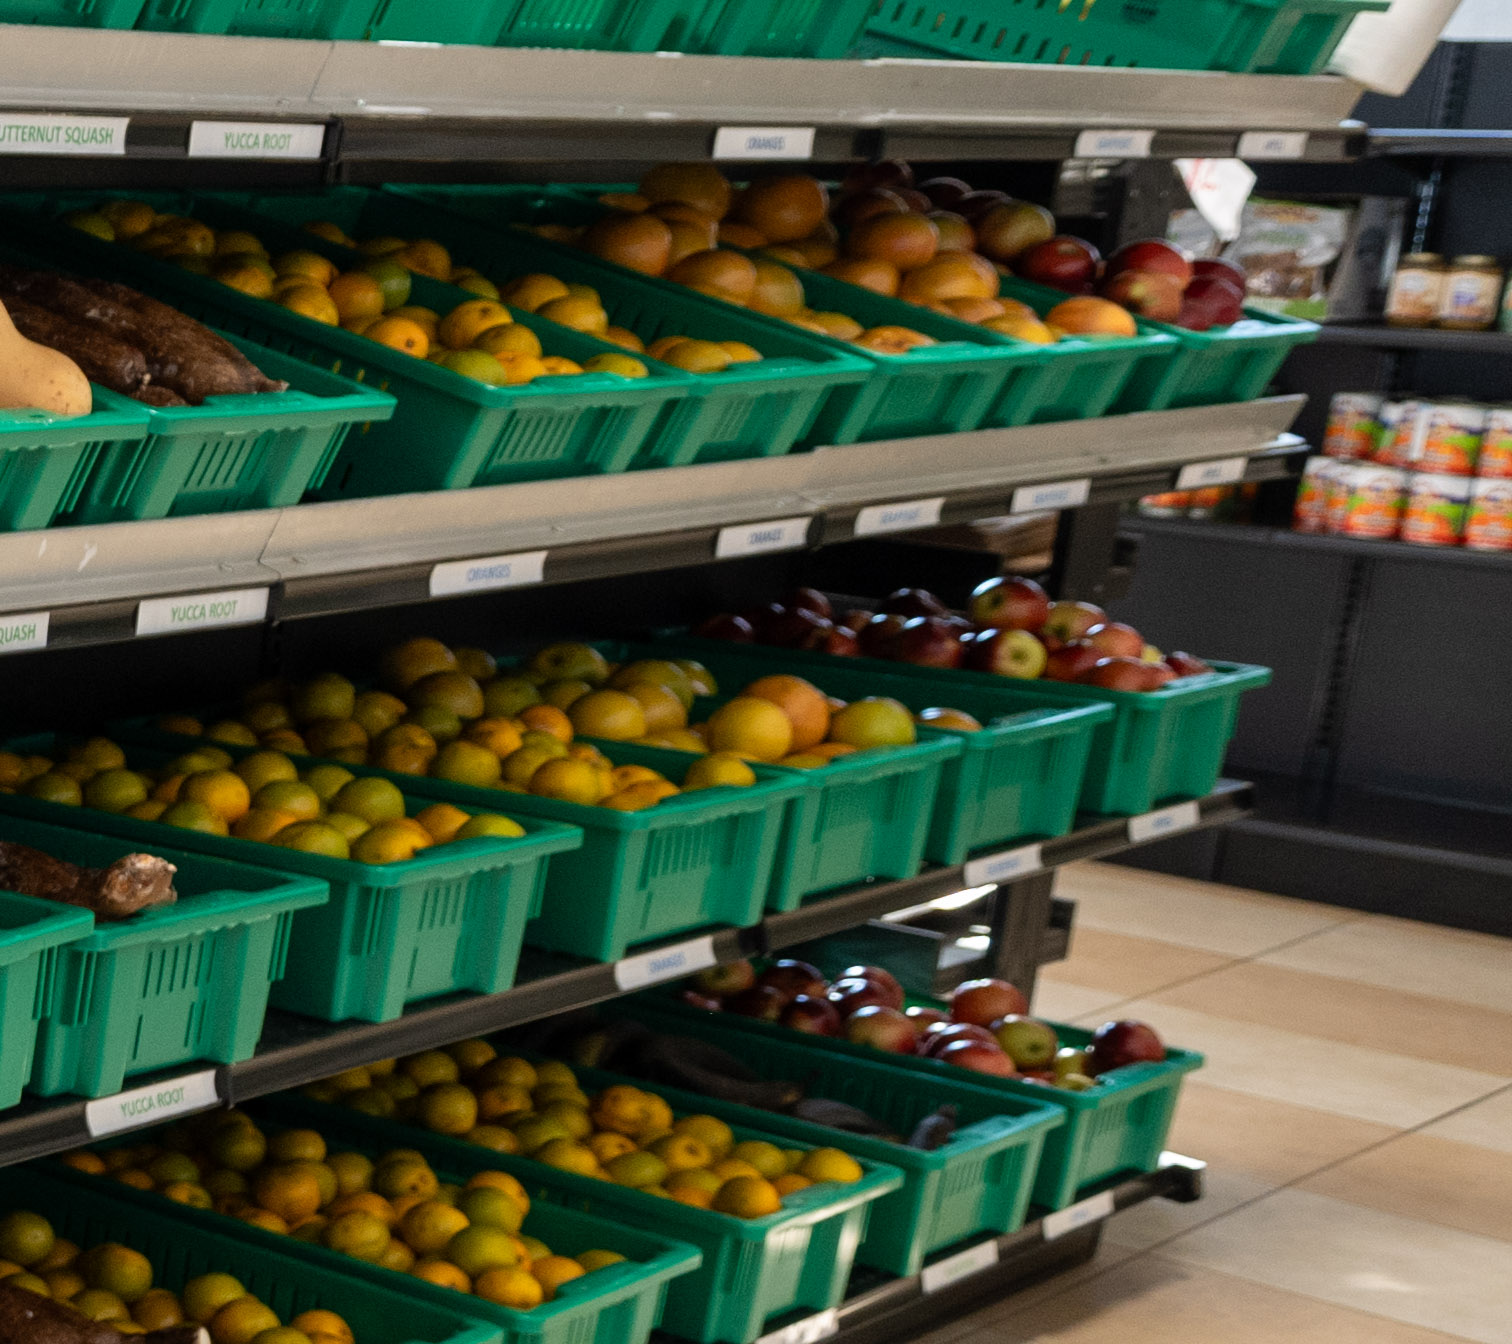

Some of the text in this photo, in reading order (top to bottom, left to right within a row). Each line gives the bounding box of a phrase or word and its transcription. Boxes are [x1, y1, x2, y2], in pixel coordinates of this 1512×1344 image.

[64, 125, 114, 145] SQUASH
[223, 131, 293, 151] YUCCA ROOT
[170, 599, 239, 623] YUCCA ROOT
[119, 1086, 185, 1118] YUCCA ROOT
